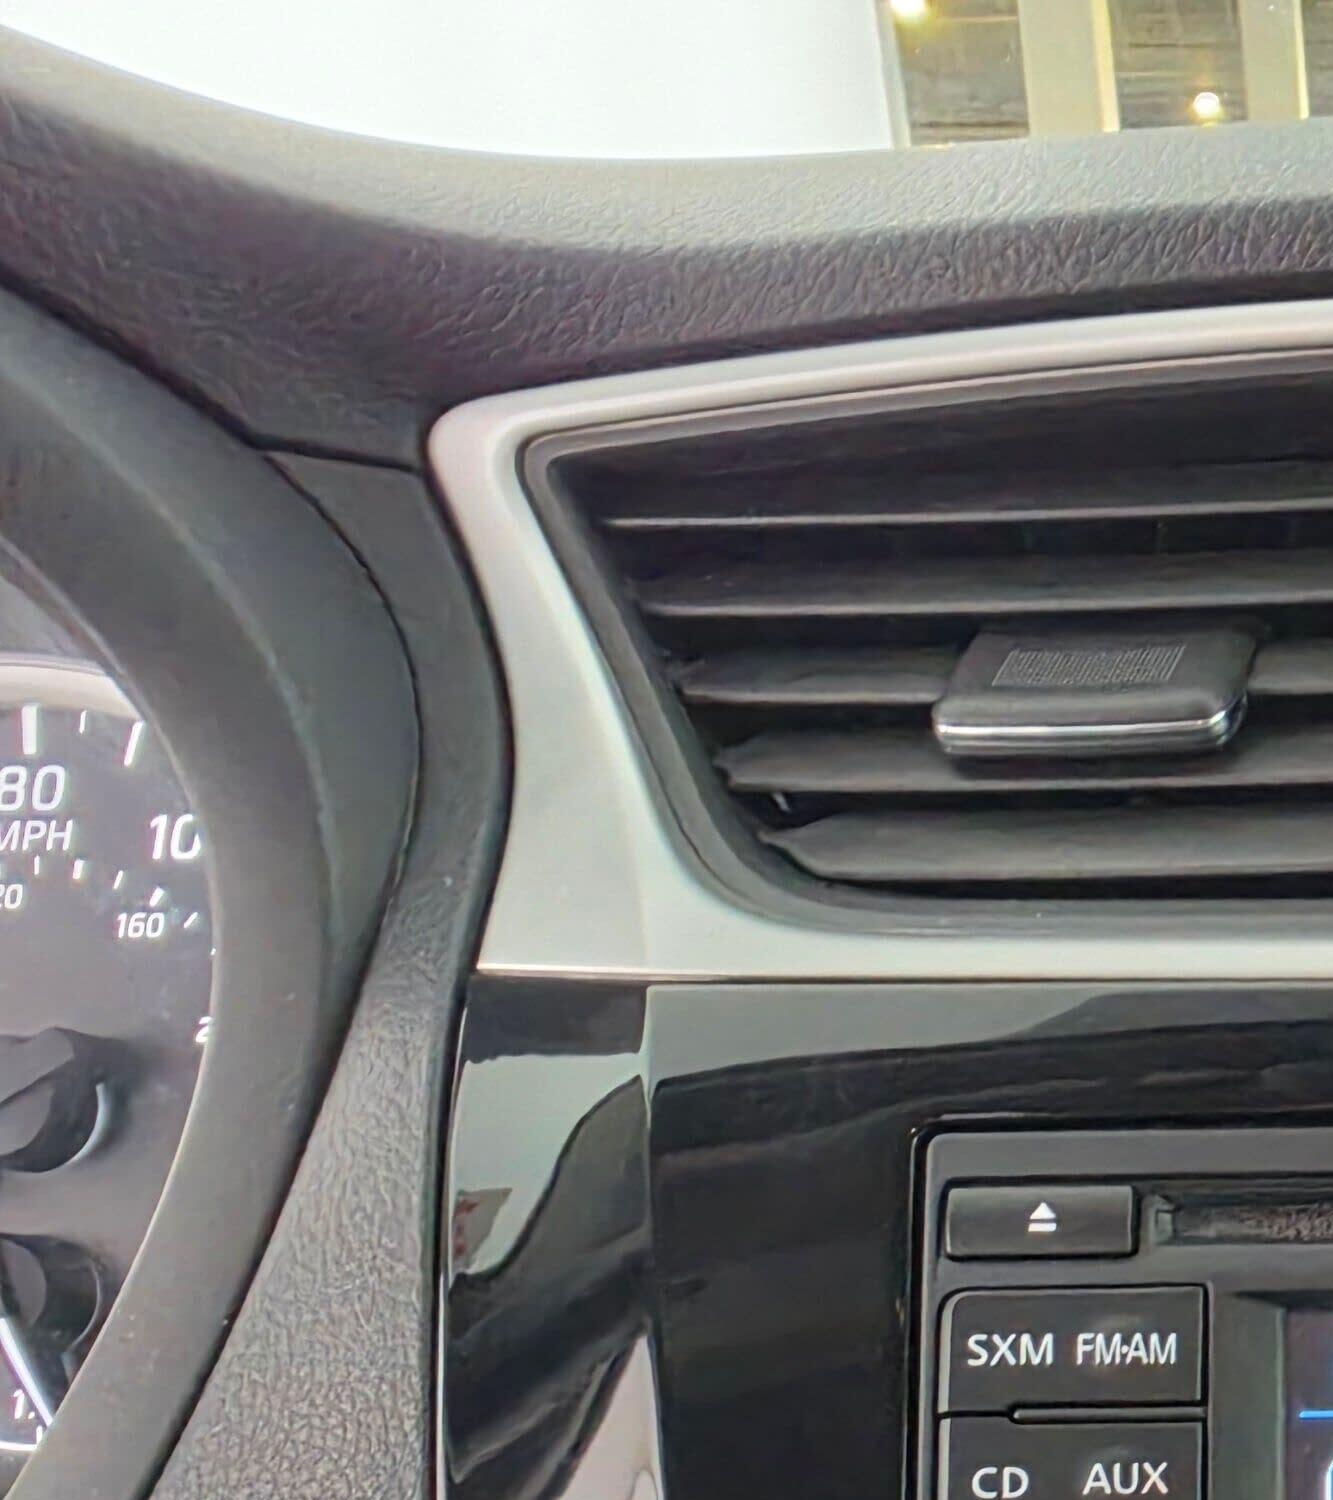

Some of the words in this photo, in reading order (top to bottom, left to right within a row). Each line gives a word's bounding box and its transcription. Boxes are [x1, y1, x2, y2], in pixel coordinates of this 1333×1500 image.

[0, 765, 66, 811] 80
[116, 911, 166, 939] 160
[966, 1332, 1054, 1367] SXM
[971, 1465, 1029, 1499] CD
[1082, 1461, 1169, 1496] AUX
